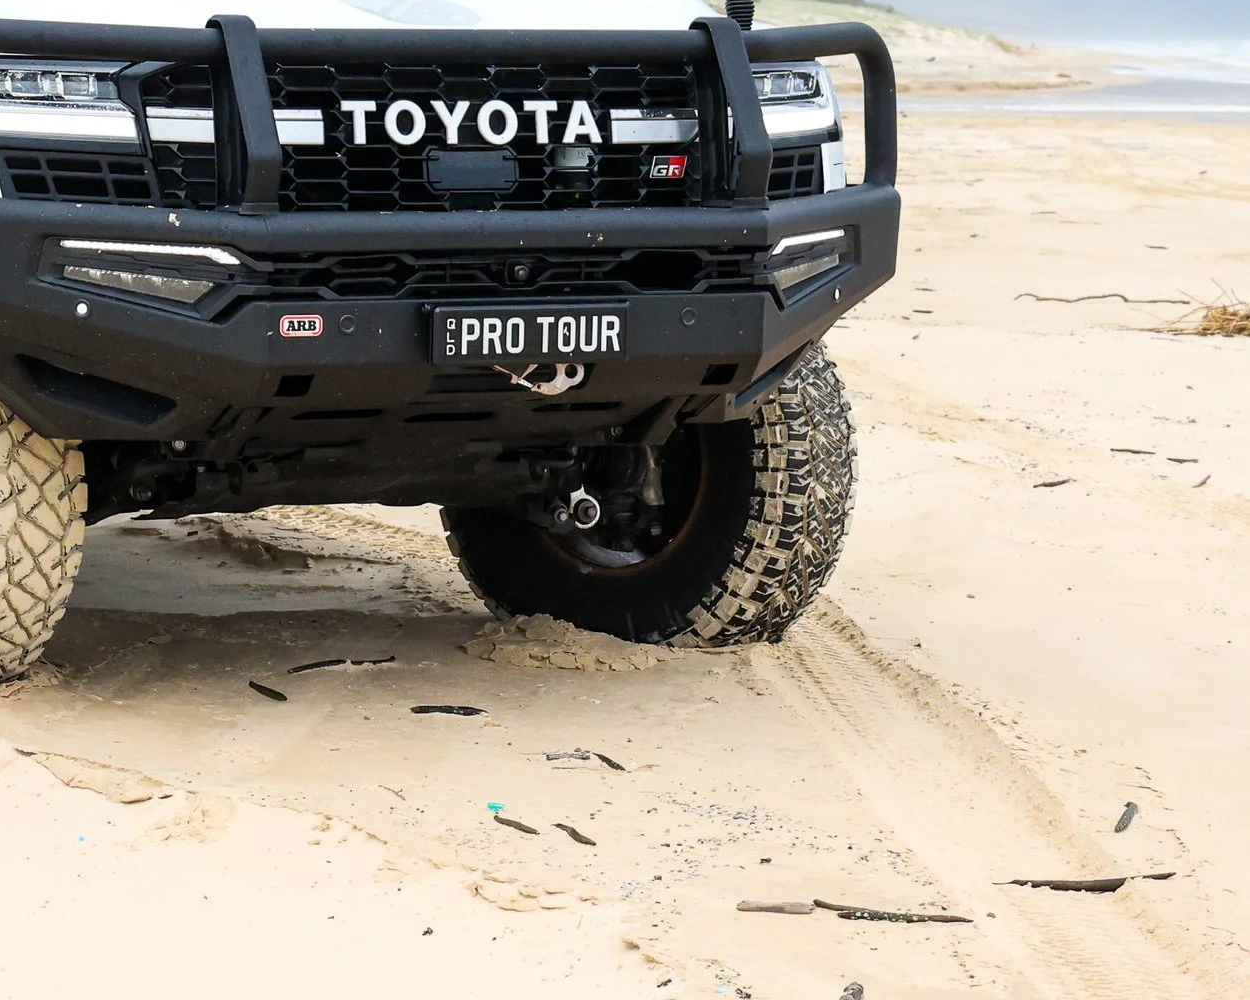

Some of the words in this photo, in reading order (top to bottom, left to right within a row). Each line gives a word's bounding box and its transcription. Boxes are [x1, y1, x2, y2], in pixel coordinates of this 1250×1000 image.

[341, 100, 603, 145] TOYOTA
[653, 164, 681, 177] GR
[286, 320, 317, 332] ARB
[446, 318, 456, 356] QLD
[461, 317, 525, 355] PRO
[536, 315, 620, 353] TOUR
